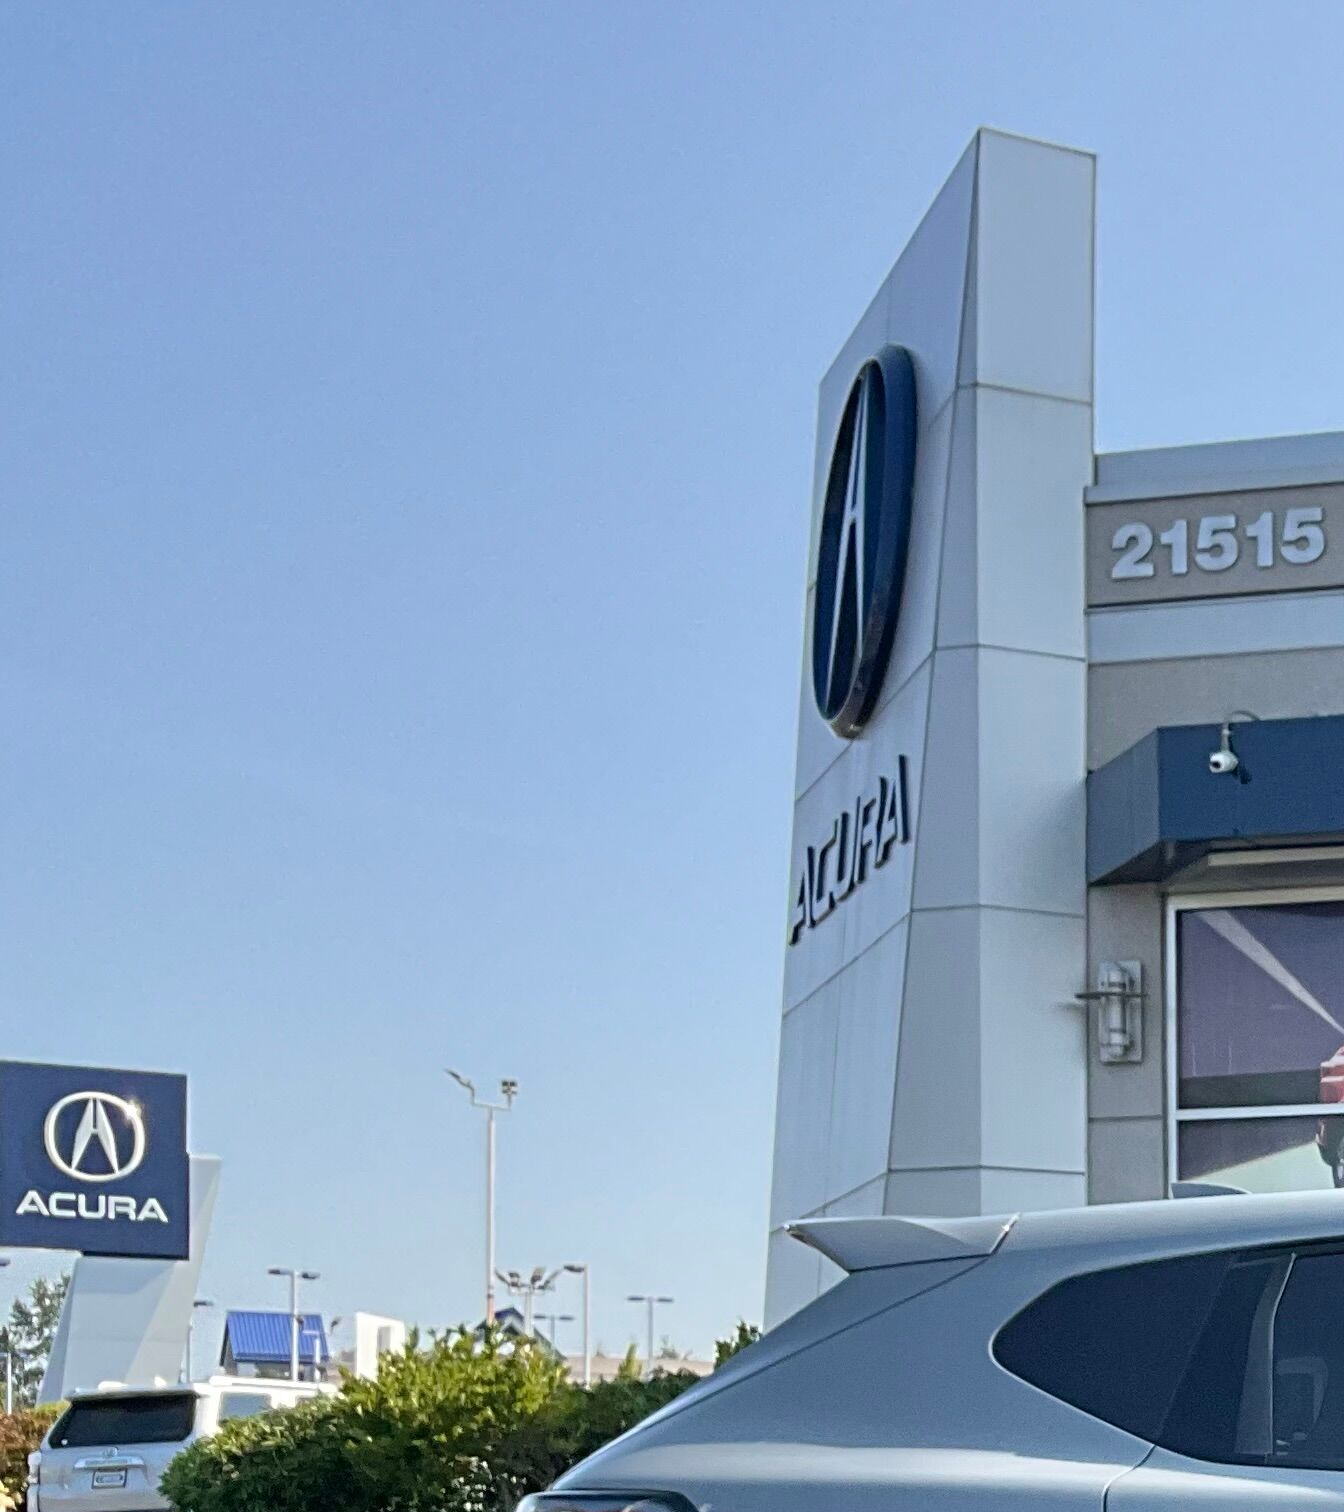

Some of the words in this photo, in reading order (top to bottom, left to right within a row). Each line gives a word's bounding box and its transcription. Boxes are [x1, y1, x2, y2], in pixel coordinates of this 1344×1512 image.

[1111, 507, 1326, 581] 21515
[788, 753, 911, 946] ACURA
[15, 1189, 169, 1224] ACURA
